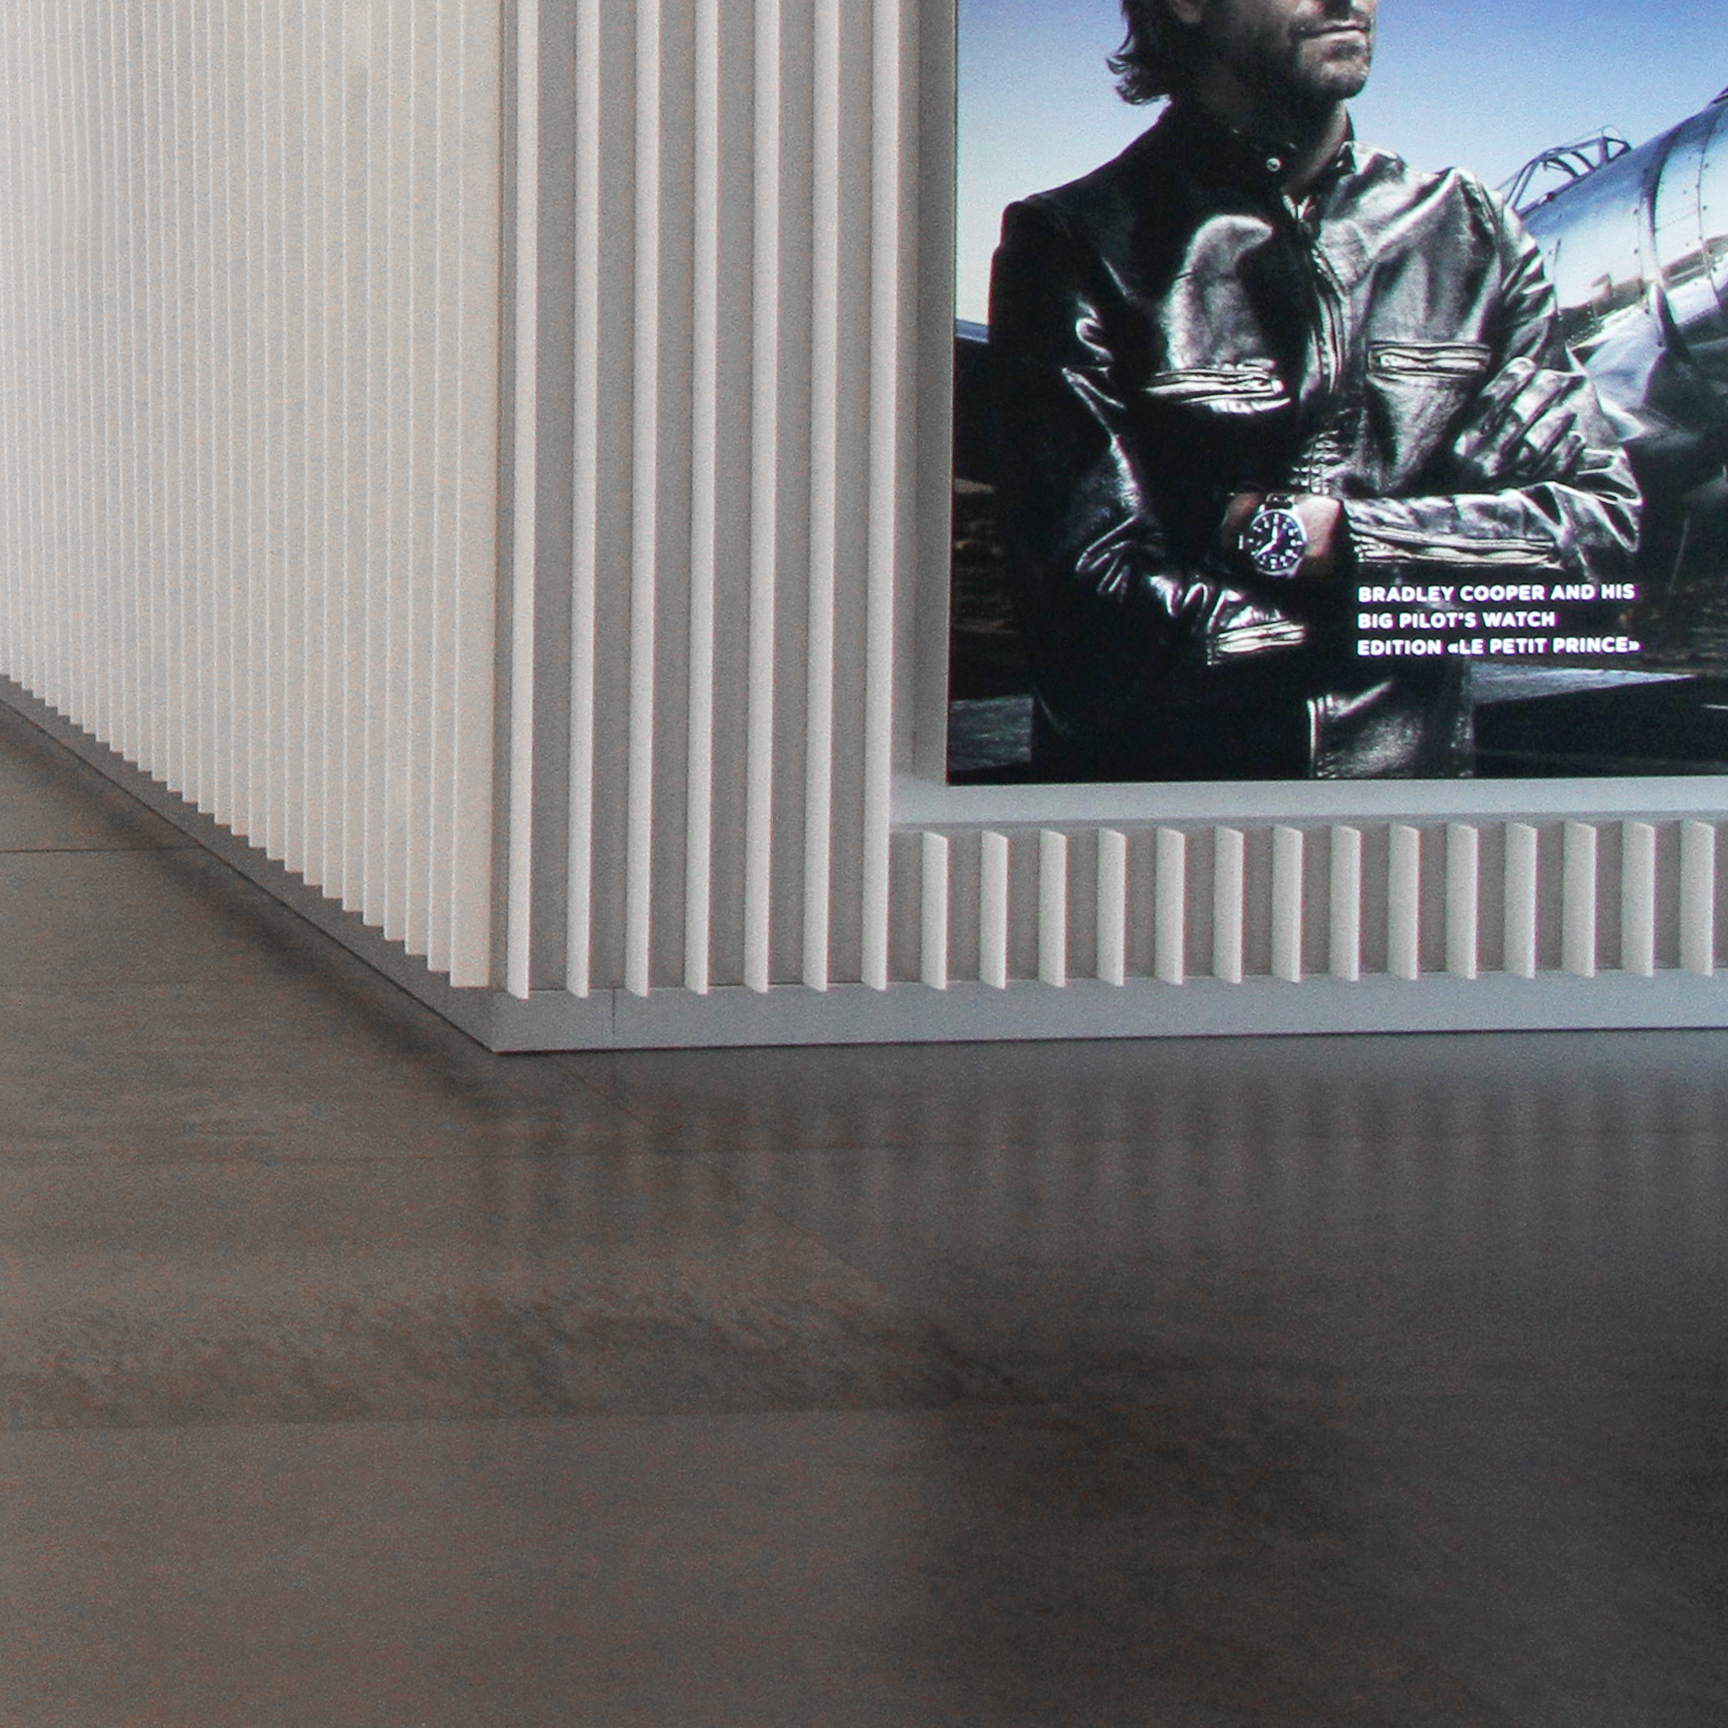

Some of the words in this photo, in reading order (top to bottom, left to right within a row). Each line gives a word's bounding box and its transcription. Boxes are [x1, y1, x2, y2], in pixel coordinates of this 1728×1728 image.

[1358, 586, 1455, 602] BRADLEY
[1459, 585, 1545, 602] COOPER
[1550, 584, 1596, 600] AND
[1601, 583, 1636, 600] HIS
[1358, 613, 1393, 629] BIG
[1399, 612, 1477, 629] PILOT'S
[1482, 611, 1555, 627] WATCH
[1357, 639, 1442, 656] EDITION
[1489, 638, 1547, 654] PETIT
